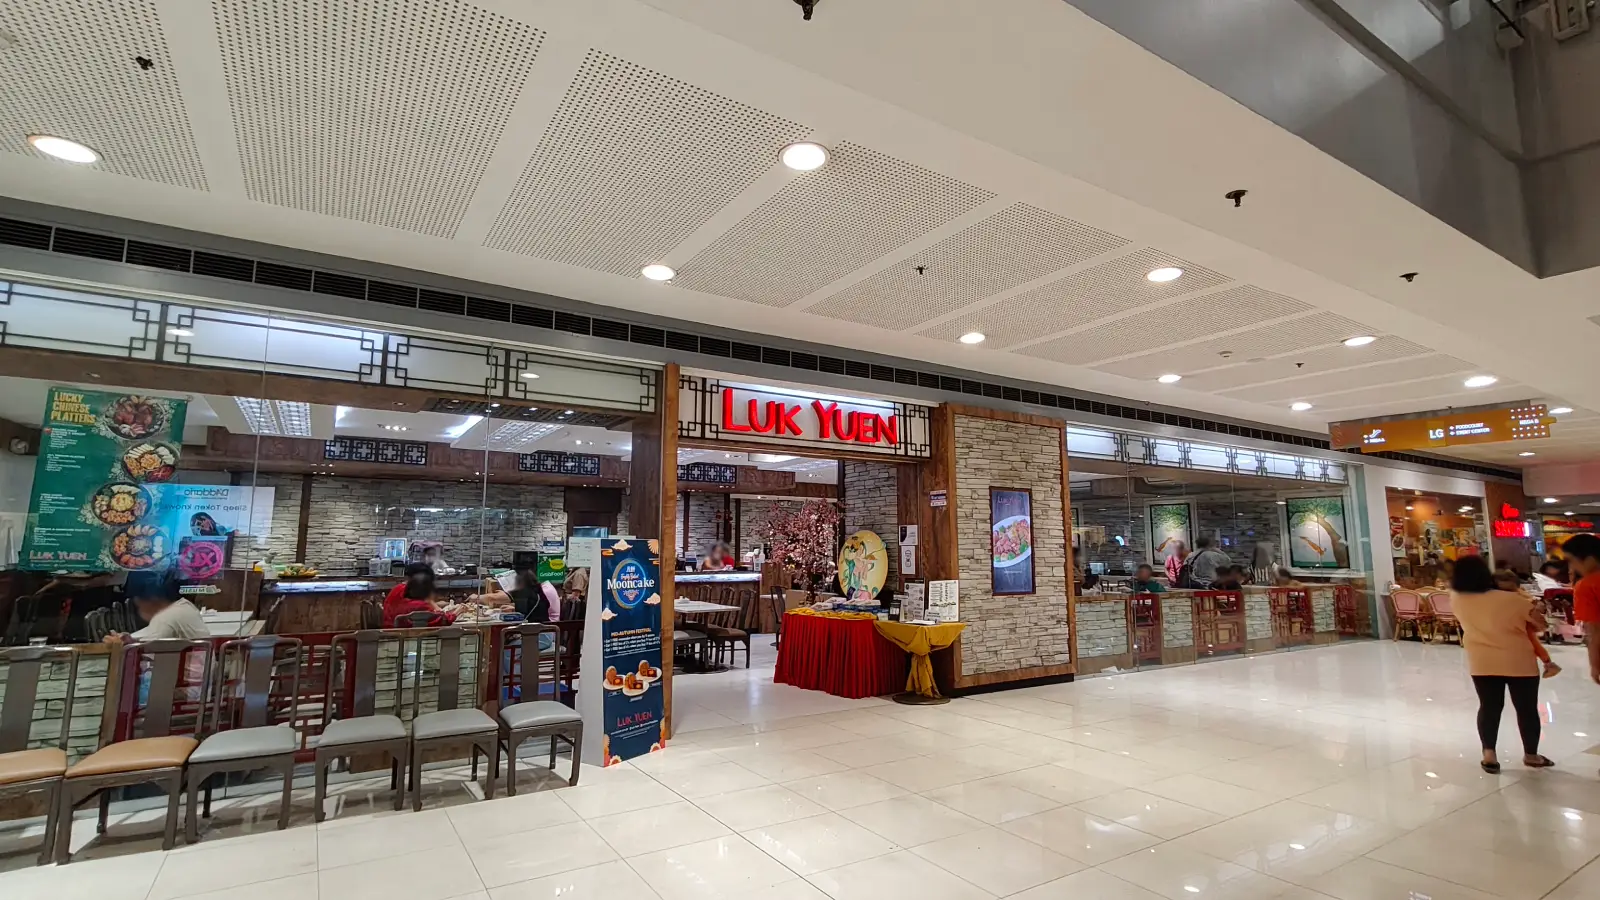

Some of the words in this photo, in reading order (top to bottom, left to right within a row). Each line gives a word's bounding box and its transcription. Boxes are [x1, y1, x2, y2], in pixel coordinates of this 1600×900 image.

[54, 392, 84, 404] LUCKY
[52, 402, 91, 414] CHINESE
[50, 410, 96, 424] PLATTERS
[722, 388, 803, 436] LUK
[811, 399, 898, 445] YUEN
[1429, 428, 1444, 440] LG
[29, 550, 54, 560] LUK
[57, 550, 88, 560] YUEN
[606, 577, 654, 590] Mooncake
[617, 716, 632, 728] LUK
[634, 710, 652, 722] YUEN
